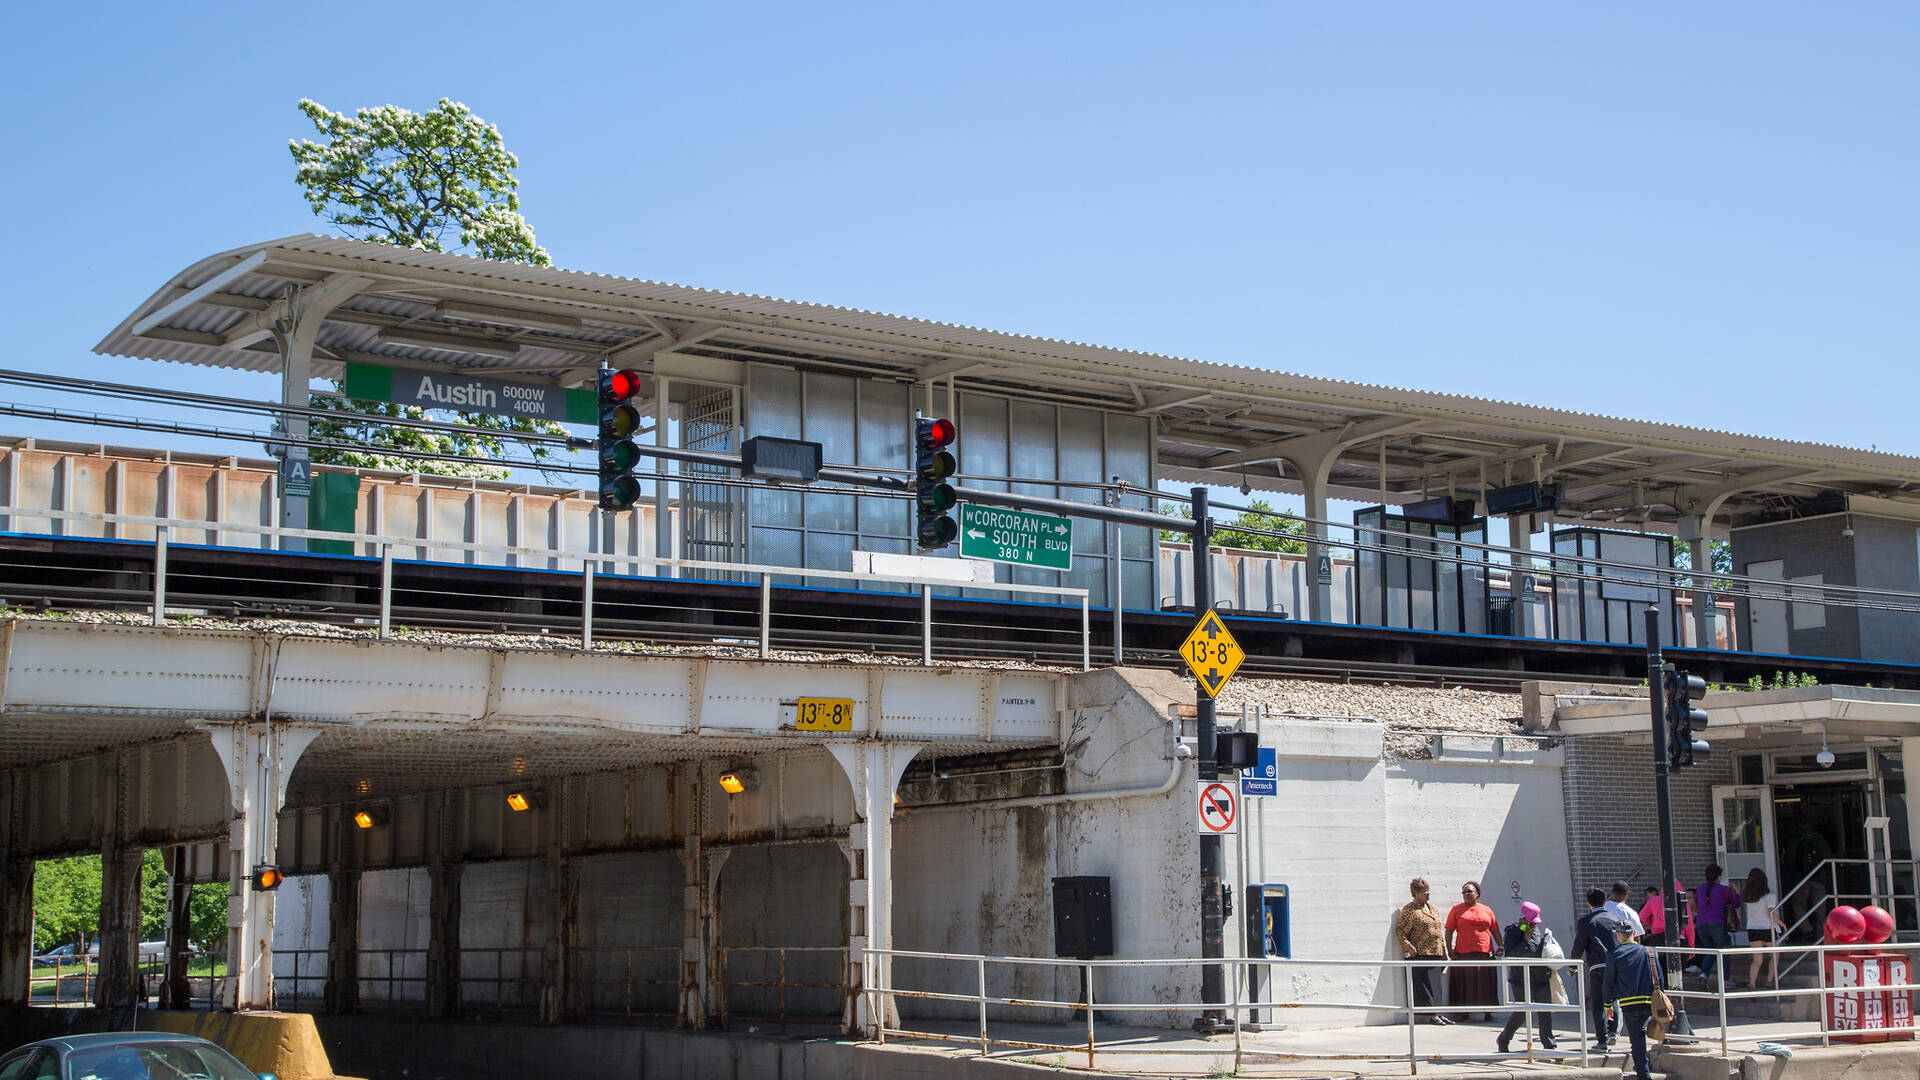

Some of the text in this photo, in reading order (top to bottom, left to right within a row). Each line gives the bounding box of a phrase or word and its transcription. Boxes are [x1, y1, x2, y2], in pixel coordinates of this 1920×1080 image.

[416, 376, 497, 408] Austin
[502, 385, 545, 401] 6000W
[513, 400, 545, 415] 400N
[291, 462, 306, 479] A
[966, 510, 1053, 534] W CORCORAN PL
[992, 530, 1068, 552] SOUTH BLVD
[998, 547, 1033, 561] 380 N
[1320, 558, 1329, 571] A
[1524, 578, 1532, 590] A
[1706, 594, 1714, 605] A
[1834, 997, 1858, 1019] ED
[1865, 1000, 1882, 1020] ED
[1892, 999, 1908, 1018] ED
